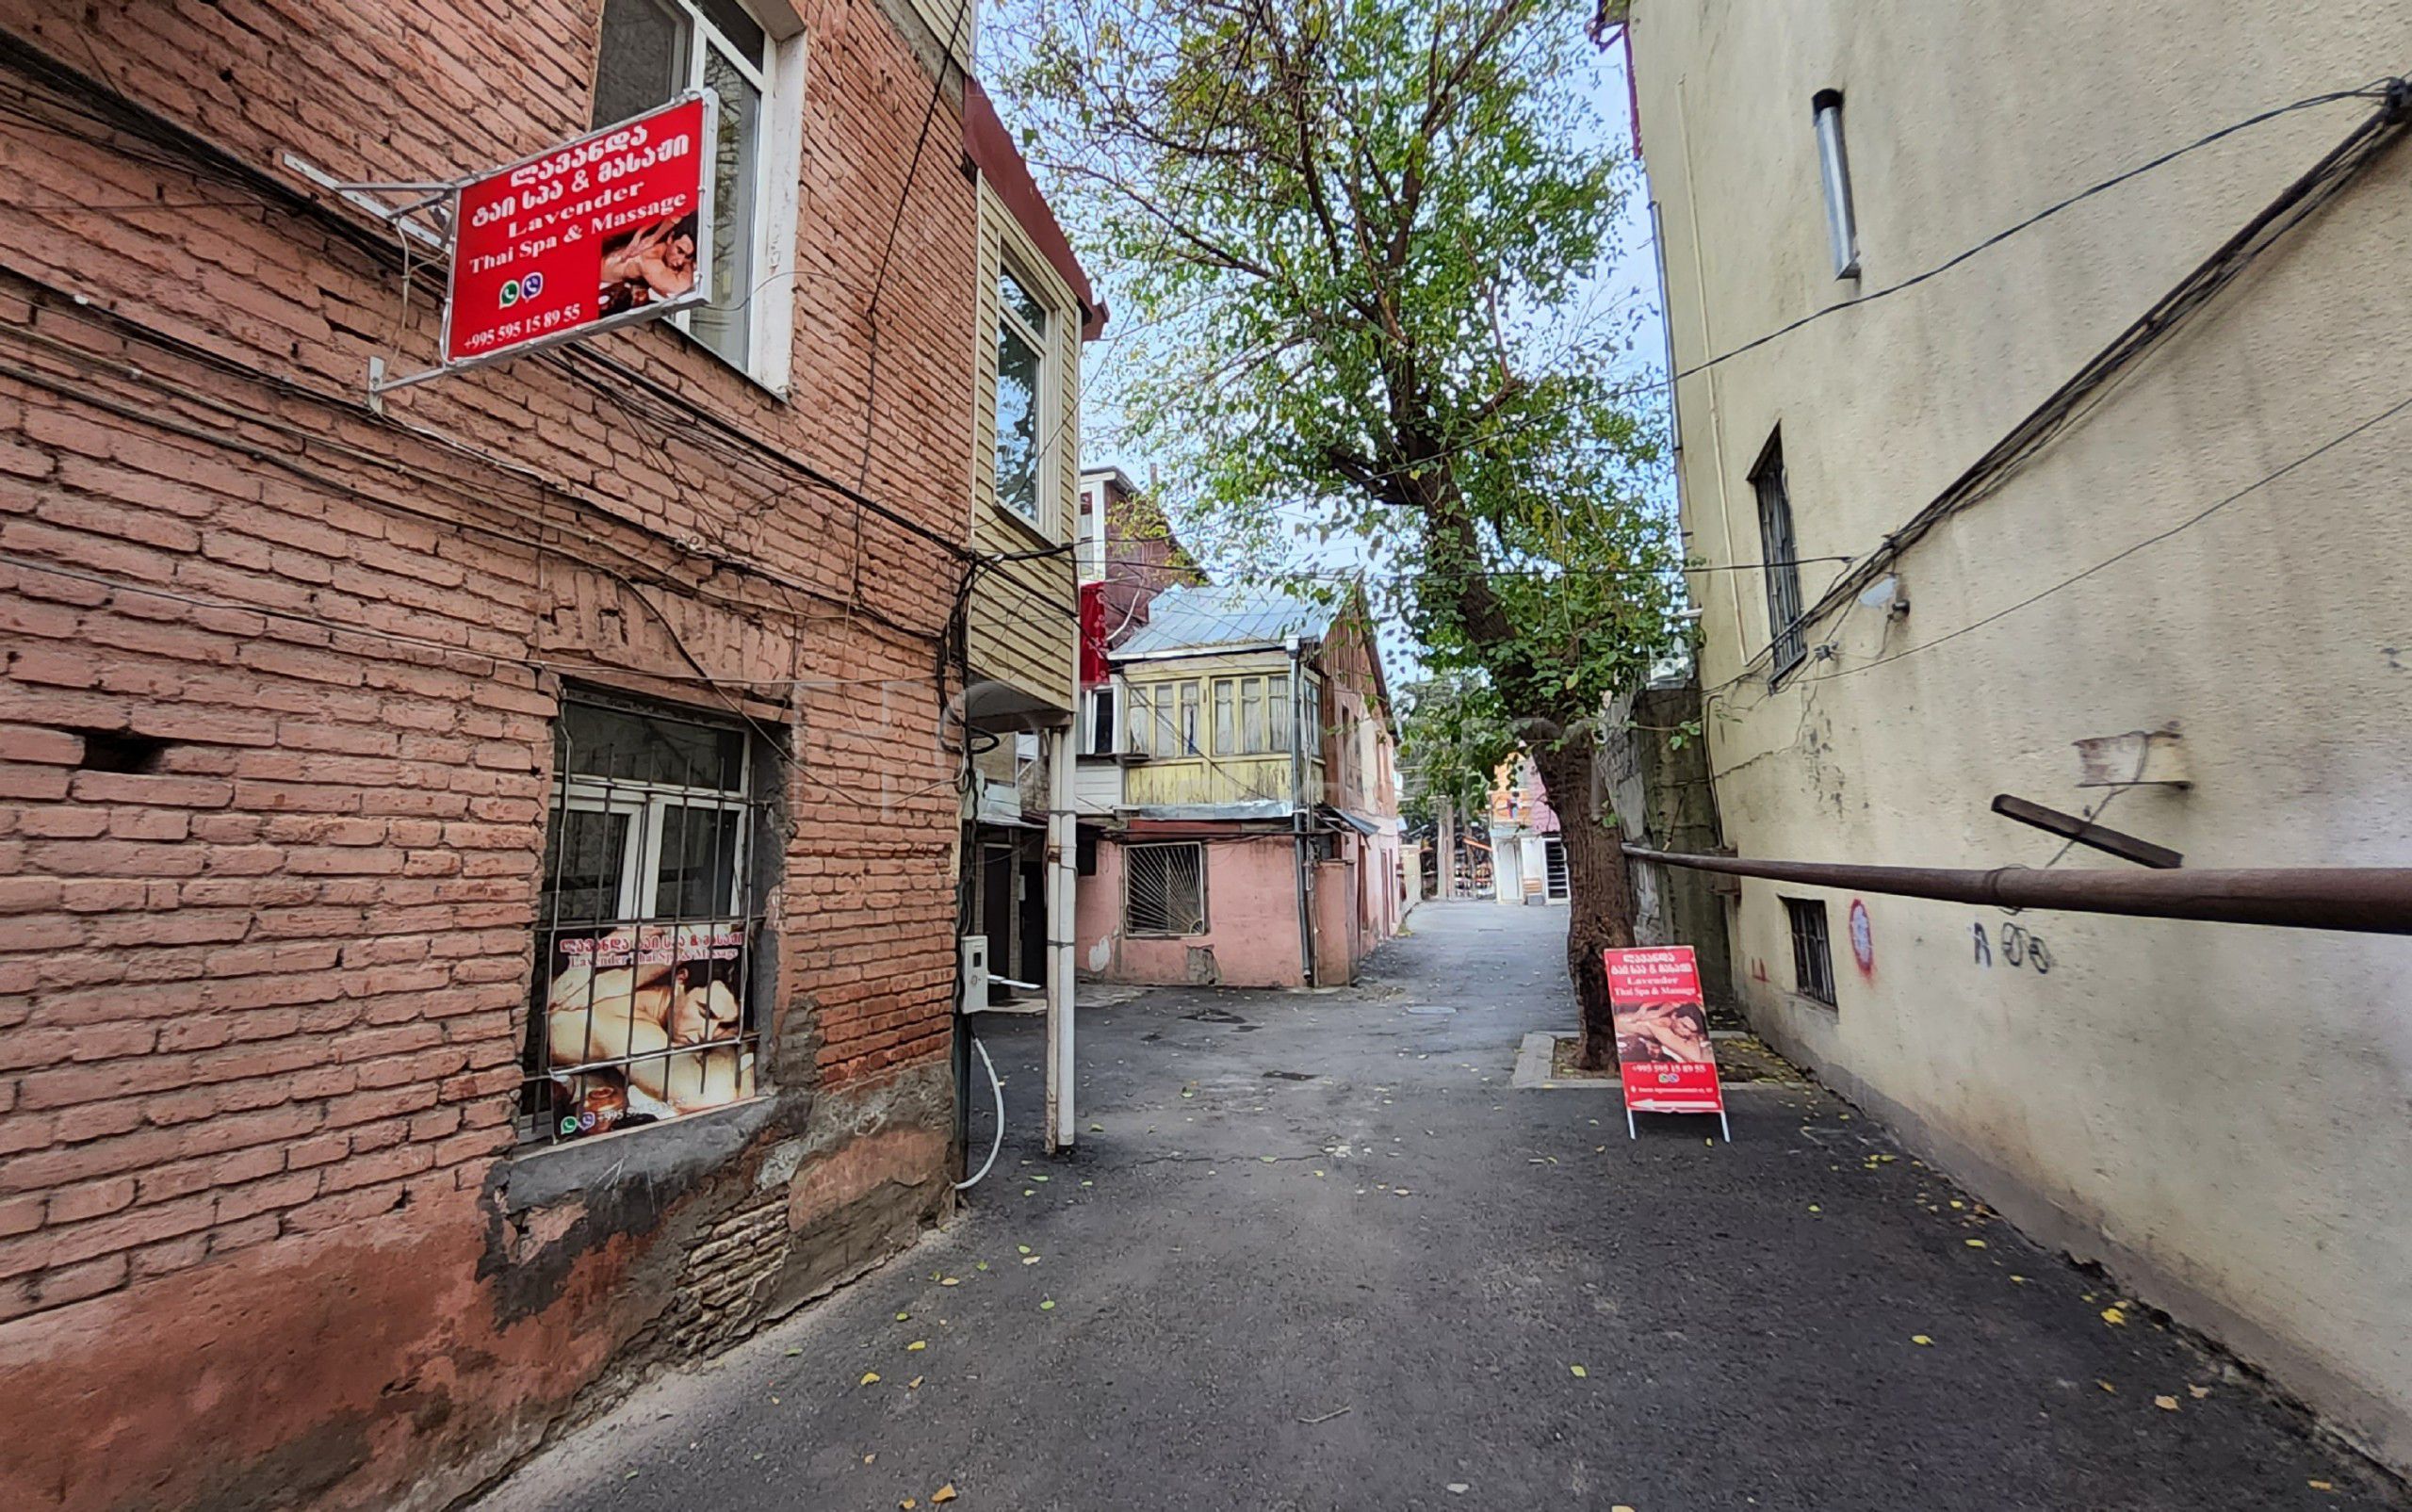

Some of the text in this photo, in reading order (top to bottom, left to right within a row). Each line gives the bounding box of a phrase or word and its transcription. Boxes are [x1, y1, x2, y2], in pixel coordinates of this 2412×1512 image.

[471, 134, 690, 228] ტაი სპა & მასაჟი
[511, 125, 648, 187] ლავანდა
[469, 192, 687, 274] Thai Spa & Massage
[507, 180, 645, 238] Lavender
[464, 302, 581, 350] +995 595 15 89 55
[570, 954, 628, 968] Lavnder
[695, 948, 739, 960] Mssage
[663, 935, 685, 949] სა
